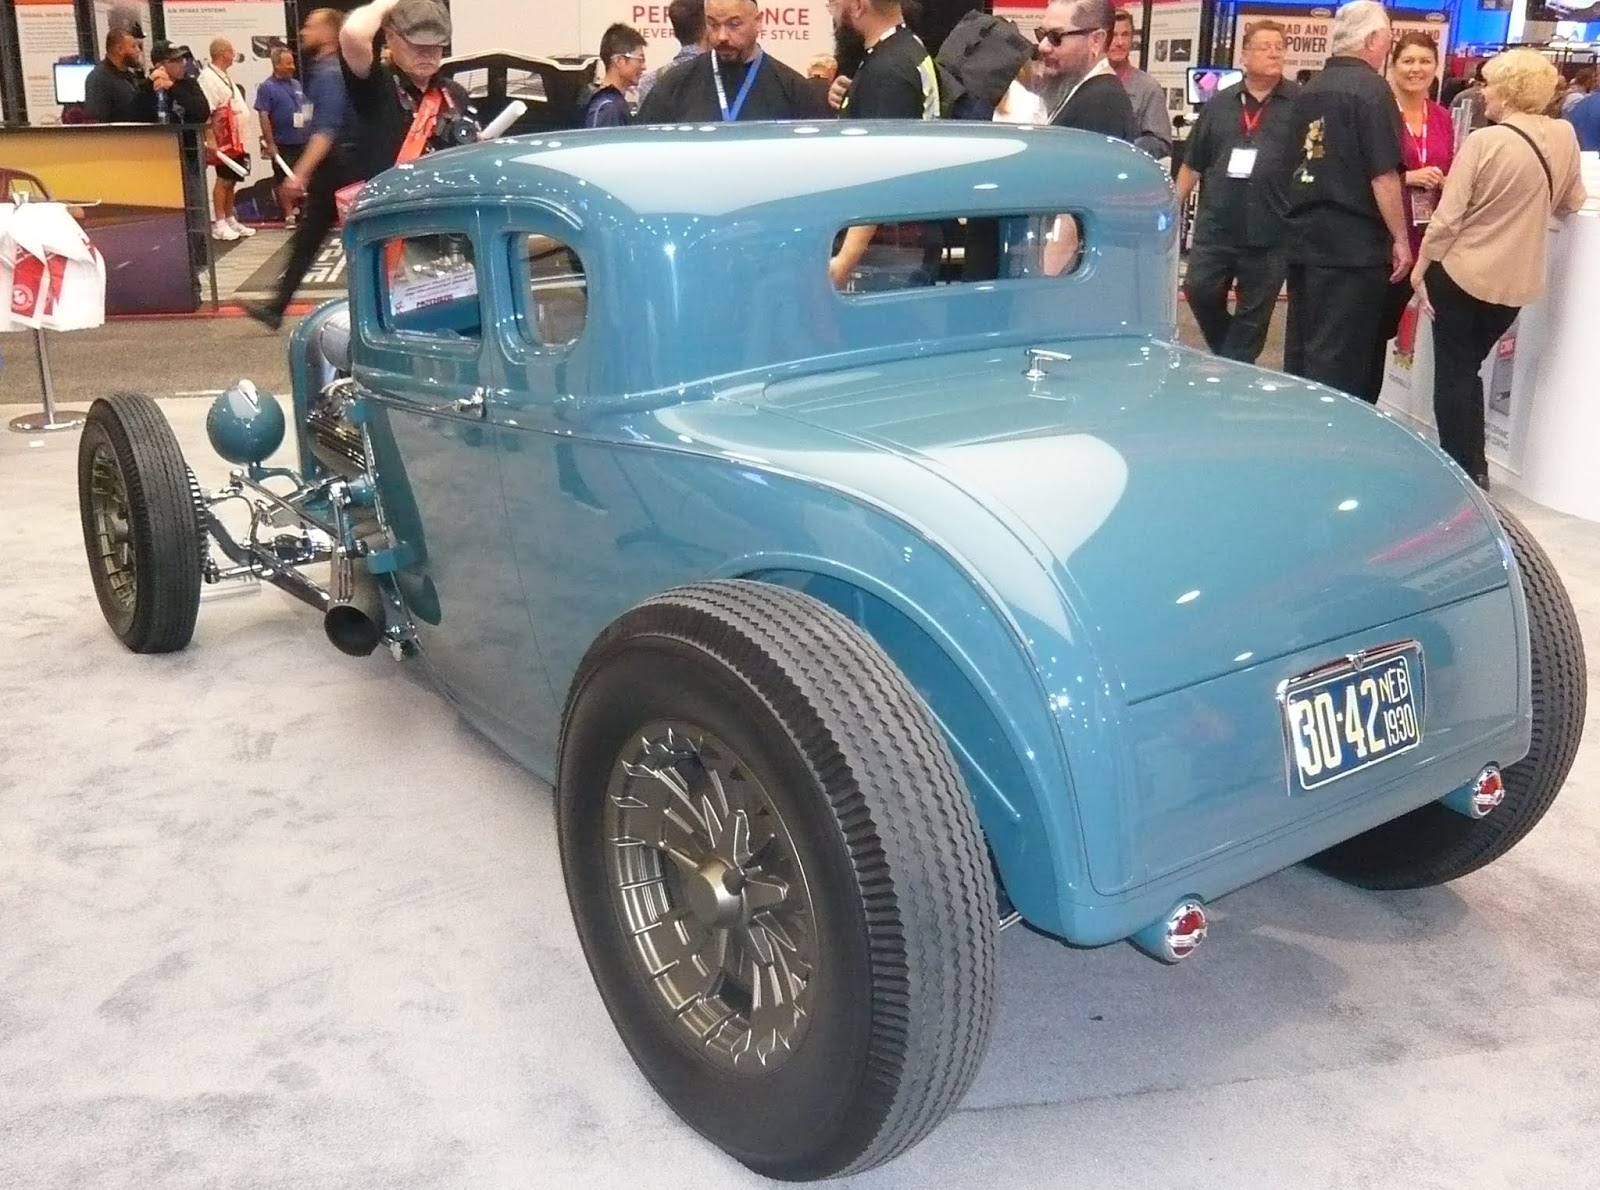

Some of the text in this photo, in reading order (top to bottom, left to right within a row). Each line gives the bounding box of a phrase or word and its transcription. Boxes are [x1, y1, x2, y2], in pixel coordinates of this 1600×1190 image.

[638, 28, 676, 39] EVER
[771, 30, 810, 40] STYLE
[1305, 24, 1328, 36] AND
[1285, 36, 1327, 53] POWER
[1379, 668, 1408, 704] NEB
[1383, 703, 1415, 746] 1930
